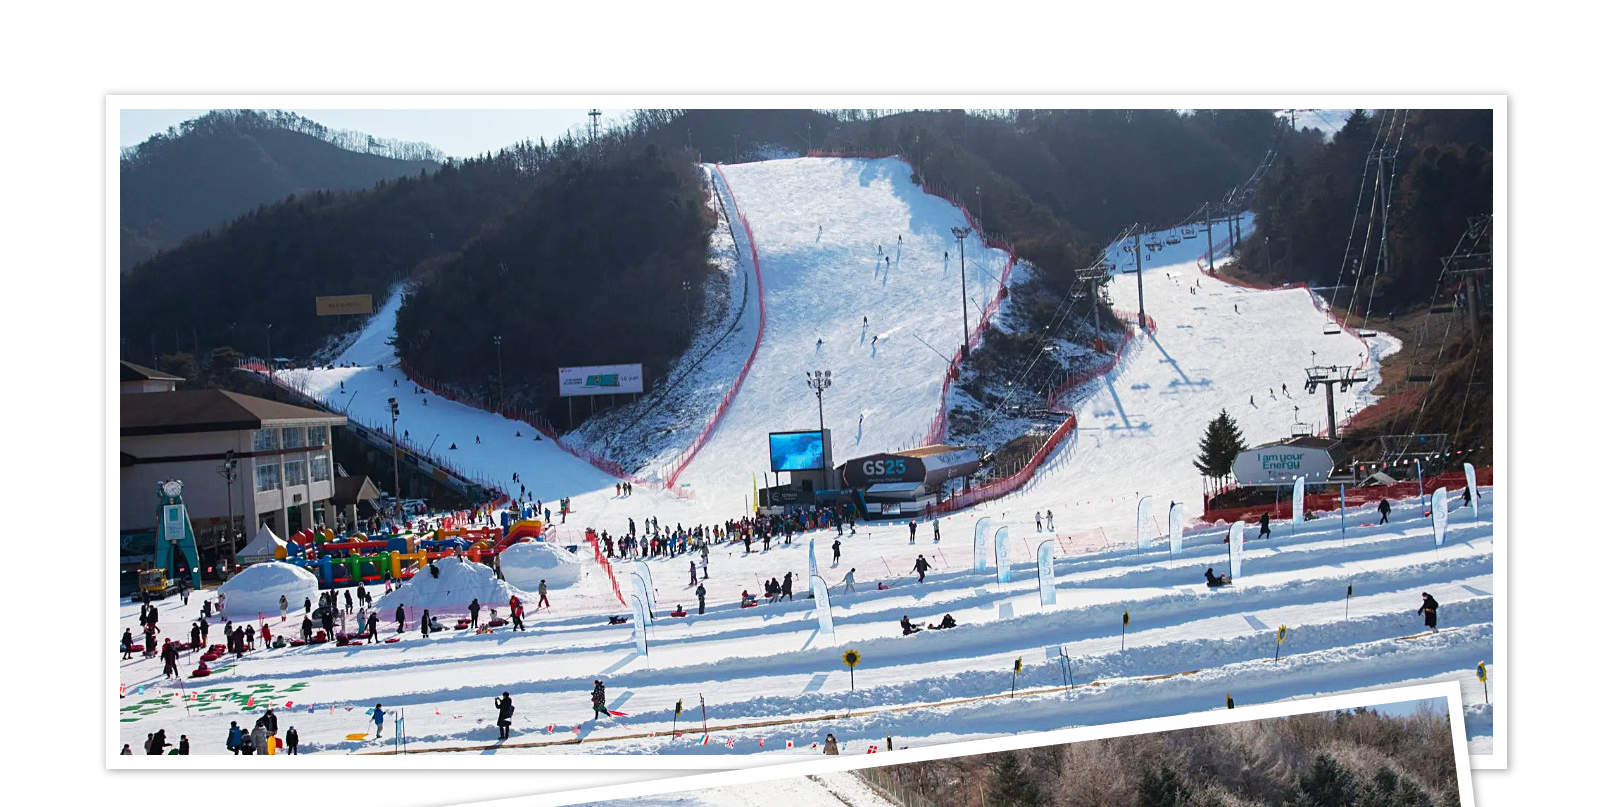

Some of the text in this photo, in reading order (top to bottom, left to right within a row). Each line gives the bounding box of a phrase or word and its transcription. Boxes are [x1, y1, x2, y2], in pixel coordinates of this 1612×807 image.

[1263, 454, 1278, 462] am
[1280, 453, 1304, 463] your
[862, 459, 906, 475] GS25
[1263, 461, 1300, 470] Energy
